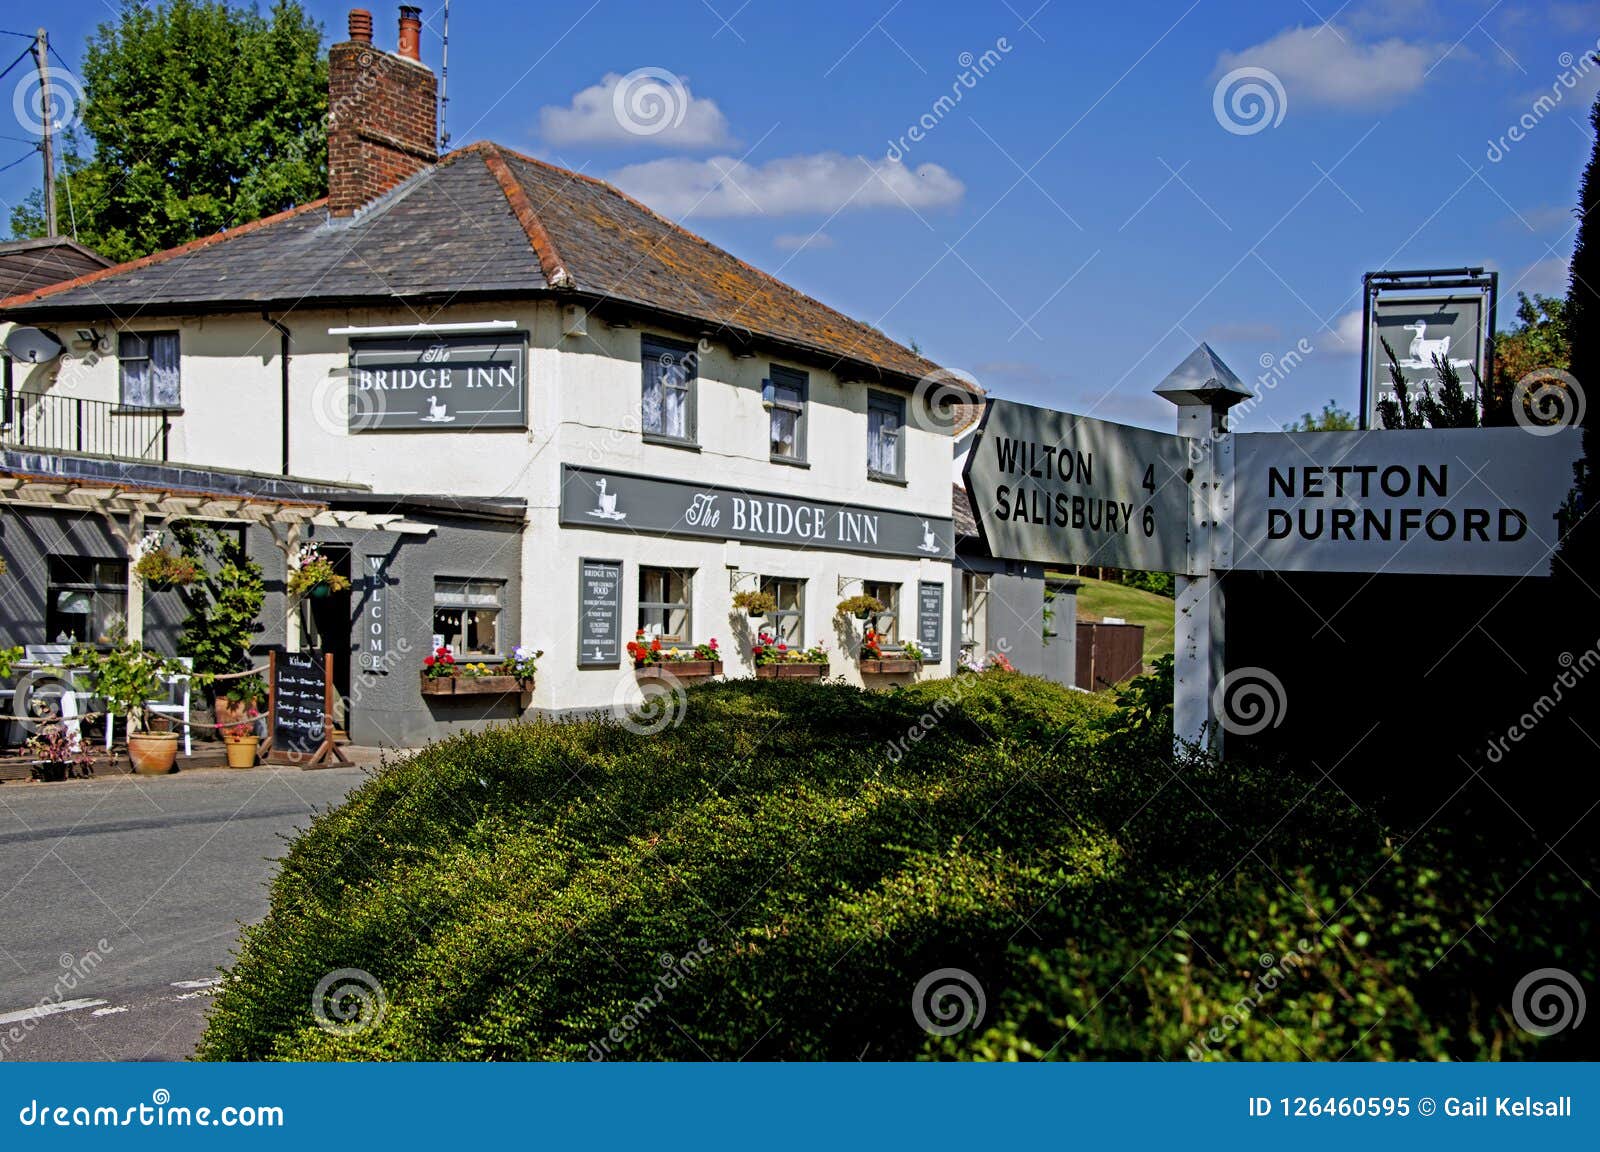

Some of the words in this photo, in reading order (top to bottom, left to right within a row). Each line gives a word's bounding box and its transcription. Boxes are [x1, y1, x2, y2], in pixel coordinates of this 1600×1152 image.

[422, 344, 449, 363] The
[359, 367, 453, 390] BRIDGE
[466, 365, 517, 388] INN
[996, 436, 1092, 485] WILTON
[1142, 463, 1156, 495] 4
[1268, 464, 1448, 498] NETTON
[685, 493, 721, 528] The
[732, 497, 826, 539] BRIDGE
[837, 511, 879, 545] INN
[995, 485, 1133, 534] SALISBURY
[1142, 505, 1155, 538] 6
[1267, 508, 1528, 542] DURNFORD
[370, 557, 384, 667] WELCOME
